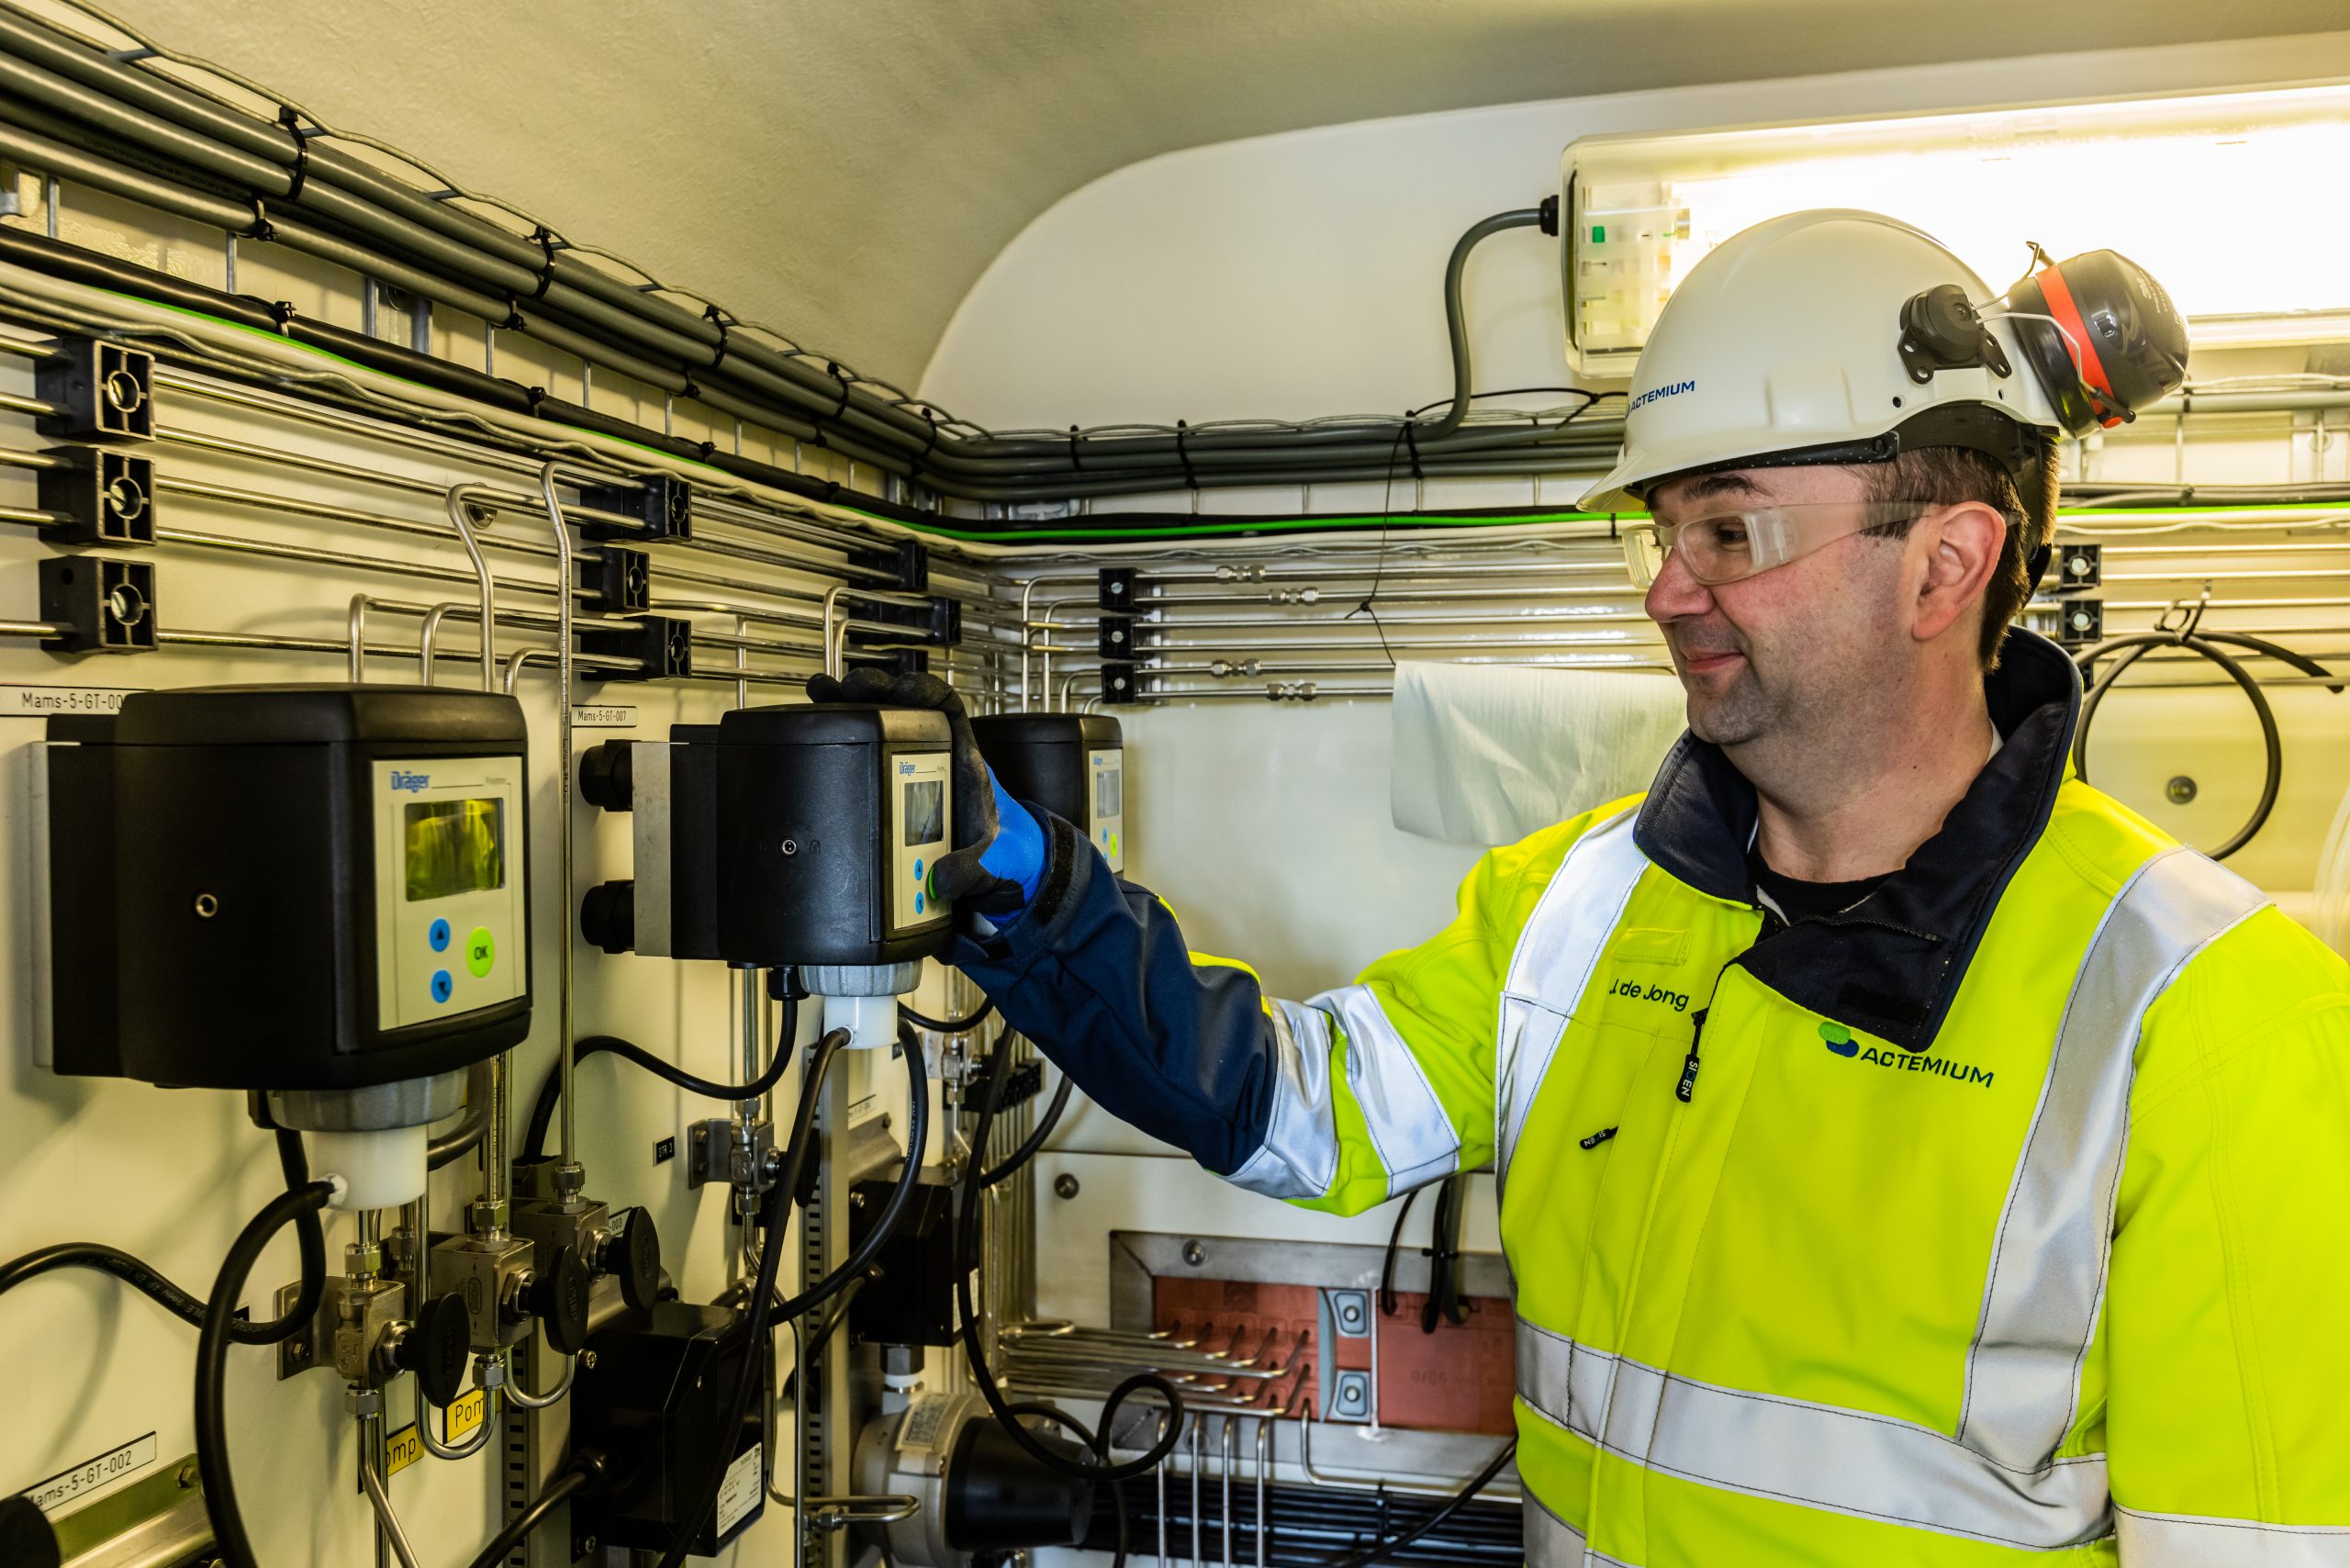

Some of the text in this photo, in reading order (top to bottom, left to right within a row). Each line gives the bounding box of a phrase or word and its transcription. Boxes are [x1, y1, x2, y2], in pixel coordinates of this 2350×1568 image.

[1630, 381, 1695, 412] ACTEMIUM
[22, 692, 123, 710] Mams-5-GT-00
[577, 710, 627, 722] Mams-5-GT-007
[391, 770, 431, 793] Dräger
[474, 946, 488, 960] OK
[1619, 980, 1641, 998] de
[1643, 984, 1690, 1013] Jong
[1682, 1060, 1698, 1097] SIOEN
[1861, 1047, 1995, 1089] ACTEMIUM
[455, 1397, 484, 1428] Pom
[386, 1438, 416, 1469] omp
